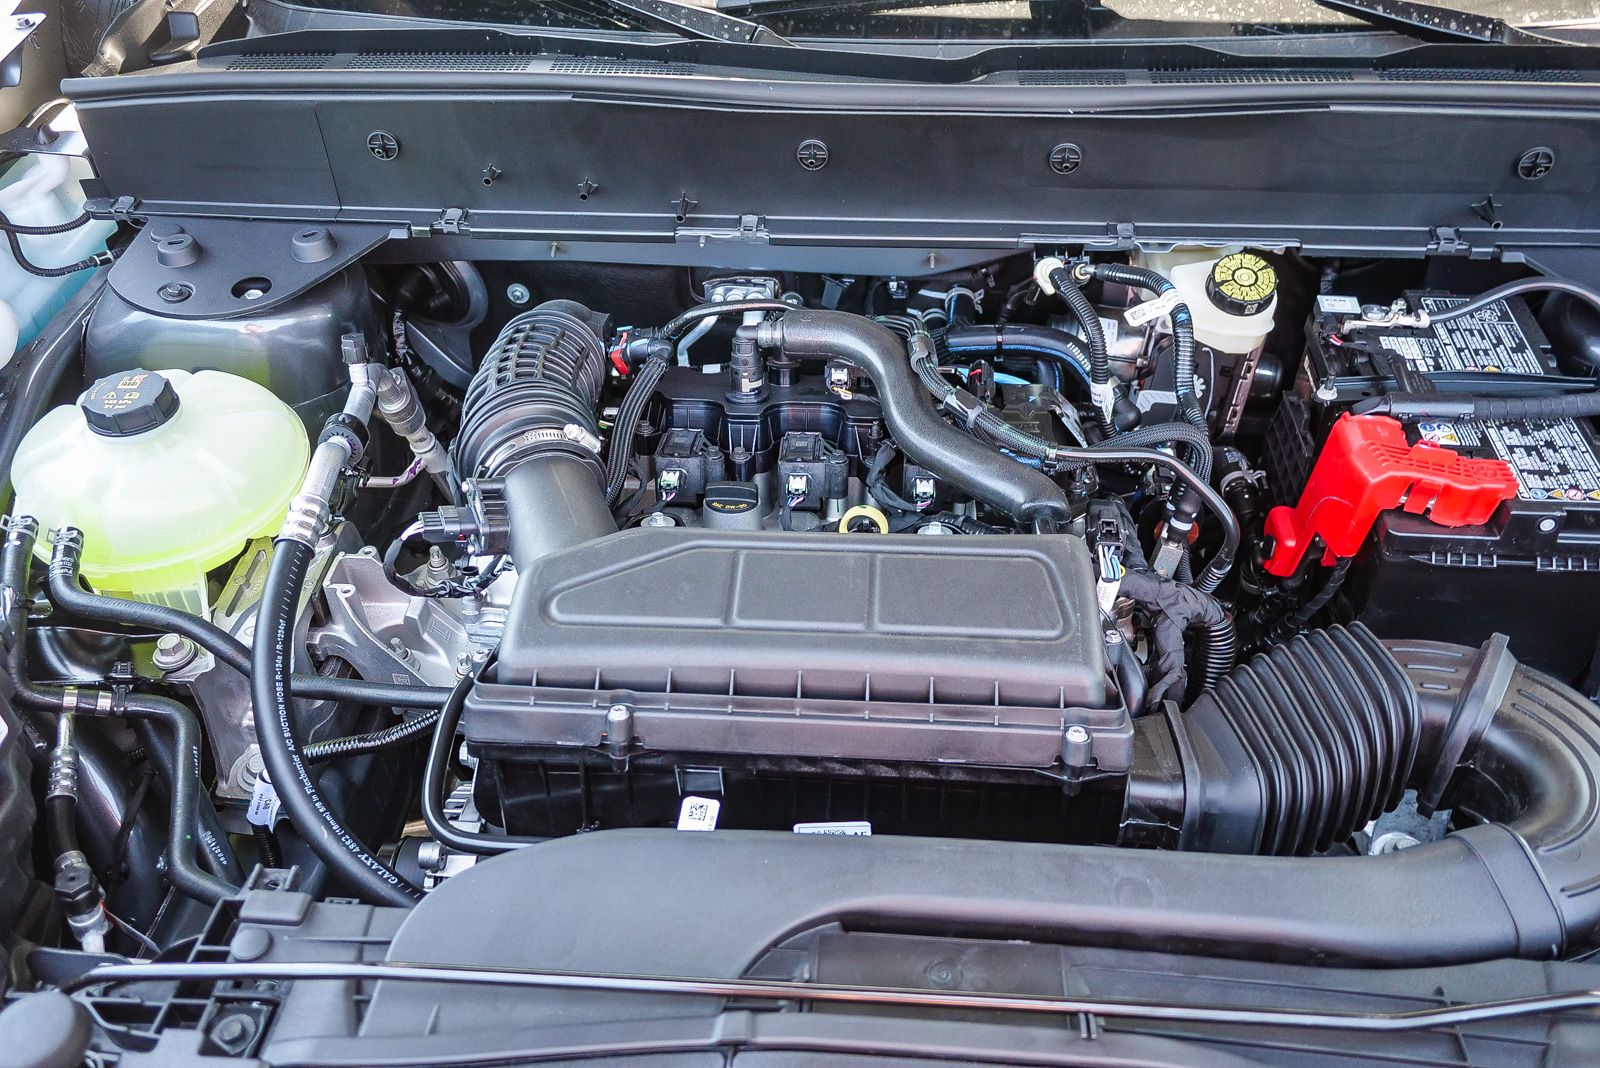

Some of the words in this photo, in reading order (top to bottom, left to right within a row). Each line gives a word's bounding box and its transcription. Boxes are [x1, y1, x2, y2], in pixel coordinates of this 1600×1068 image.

[275, 618, 286, 650] R-1234yf
[275, 655, 283, 680] R-134a
[275, 681, 285, 703] HOSE
[278, 704, 292, 738] SUCTION
[285, 738, 296, 752] A/C
[292, 754, 315, 795] Flexbarrier
[323, 811, 345, 836] (16mm)
[341, 834, 361, 853] 4882
[357, 853, 399, 885] GALAXY
